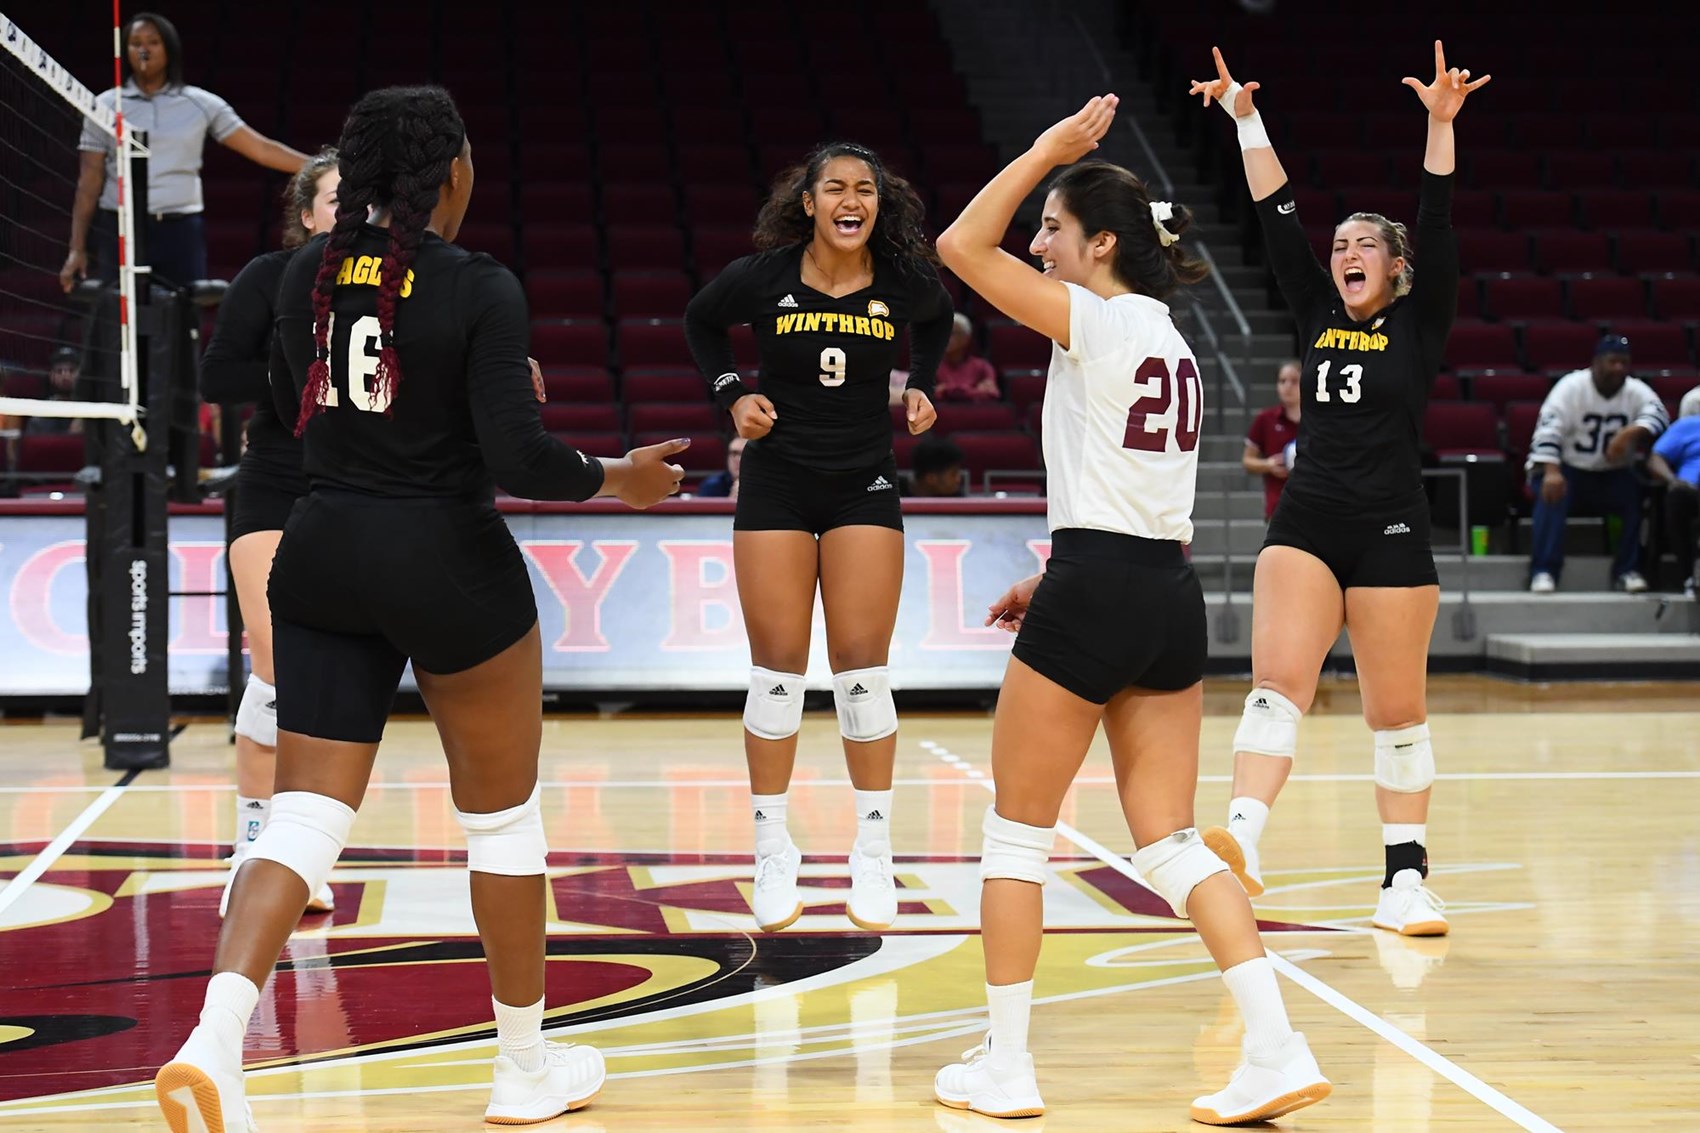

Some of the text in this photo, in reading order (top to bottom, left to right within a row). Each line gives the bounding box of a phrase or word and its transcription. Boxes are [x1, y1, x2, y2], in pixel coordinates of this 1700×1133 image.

[336, 255, 415, 298] AGLS
[776, 313, 895, 340] WINTHROP
[819, 347, 846, 387] 9
[1315, 360, 1363, 403] 13
[1122, 357, 1201, 452] 20
[128, 560, 149, 674] sports imports
